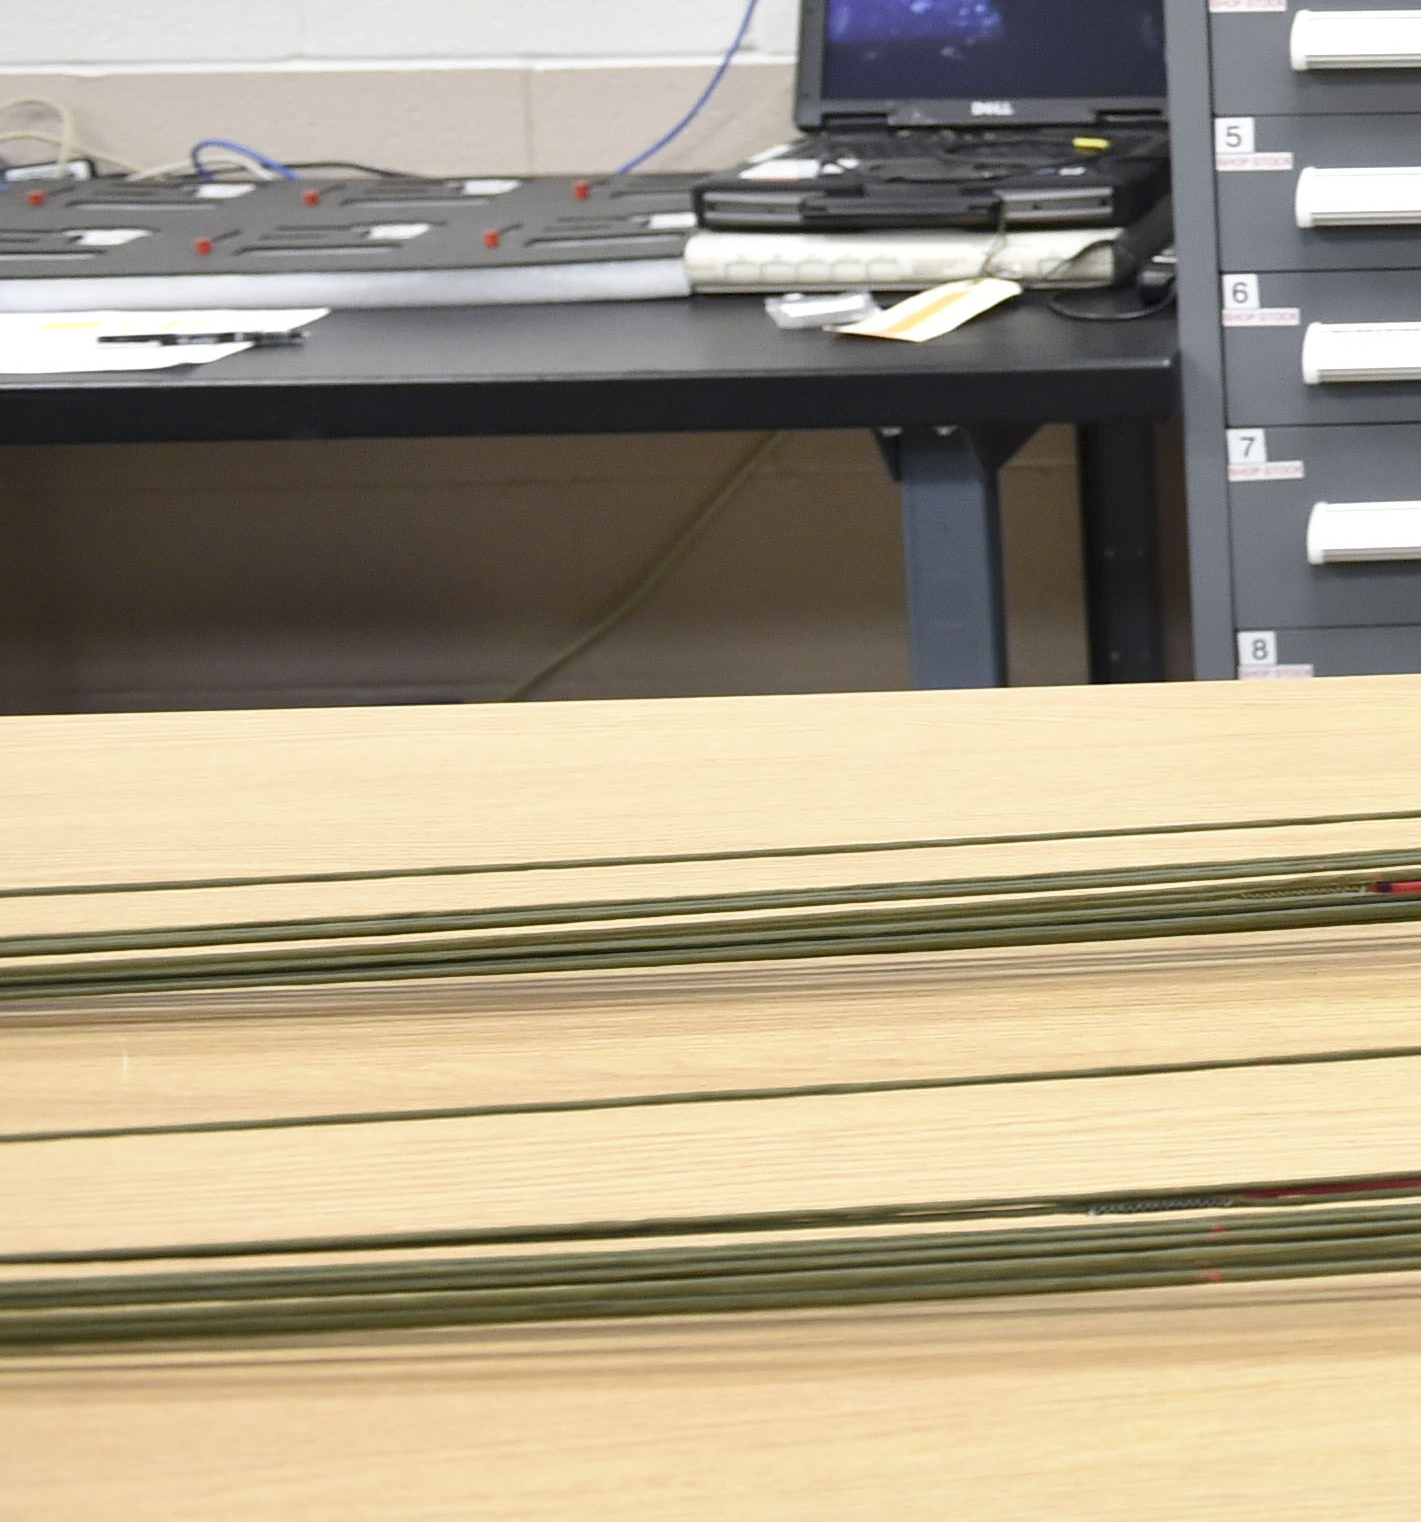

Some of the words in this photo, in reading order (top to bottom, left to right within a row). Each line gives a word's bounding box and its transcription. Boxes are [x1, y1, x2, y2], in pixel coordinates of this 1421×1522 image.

[1225, 126, 1242, 148] 5
[1232, 282, 1248, 304] 6
[1240, 436, 1256, 458] 7
[1252, 638, 1268, 660] 8
